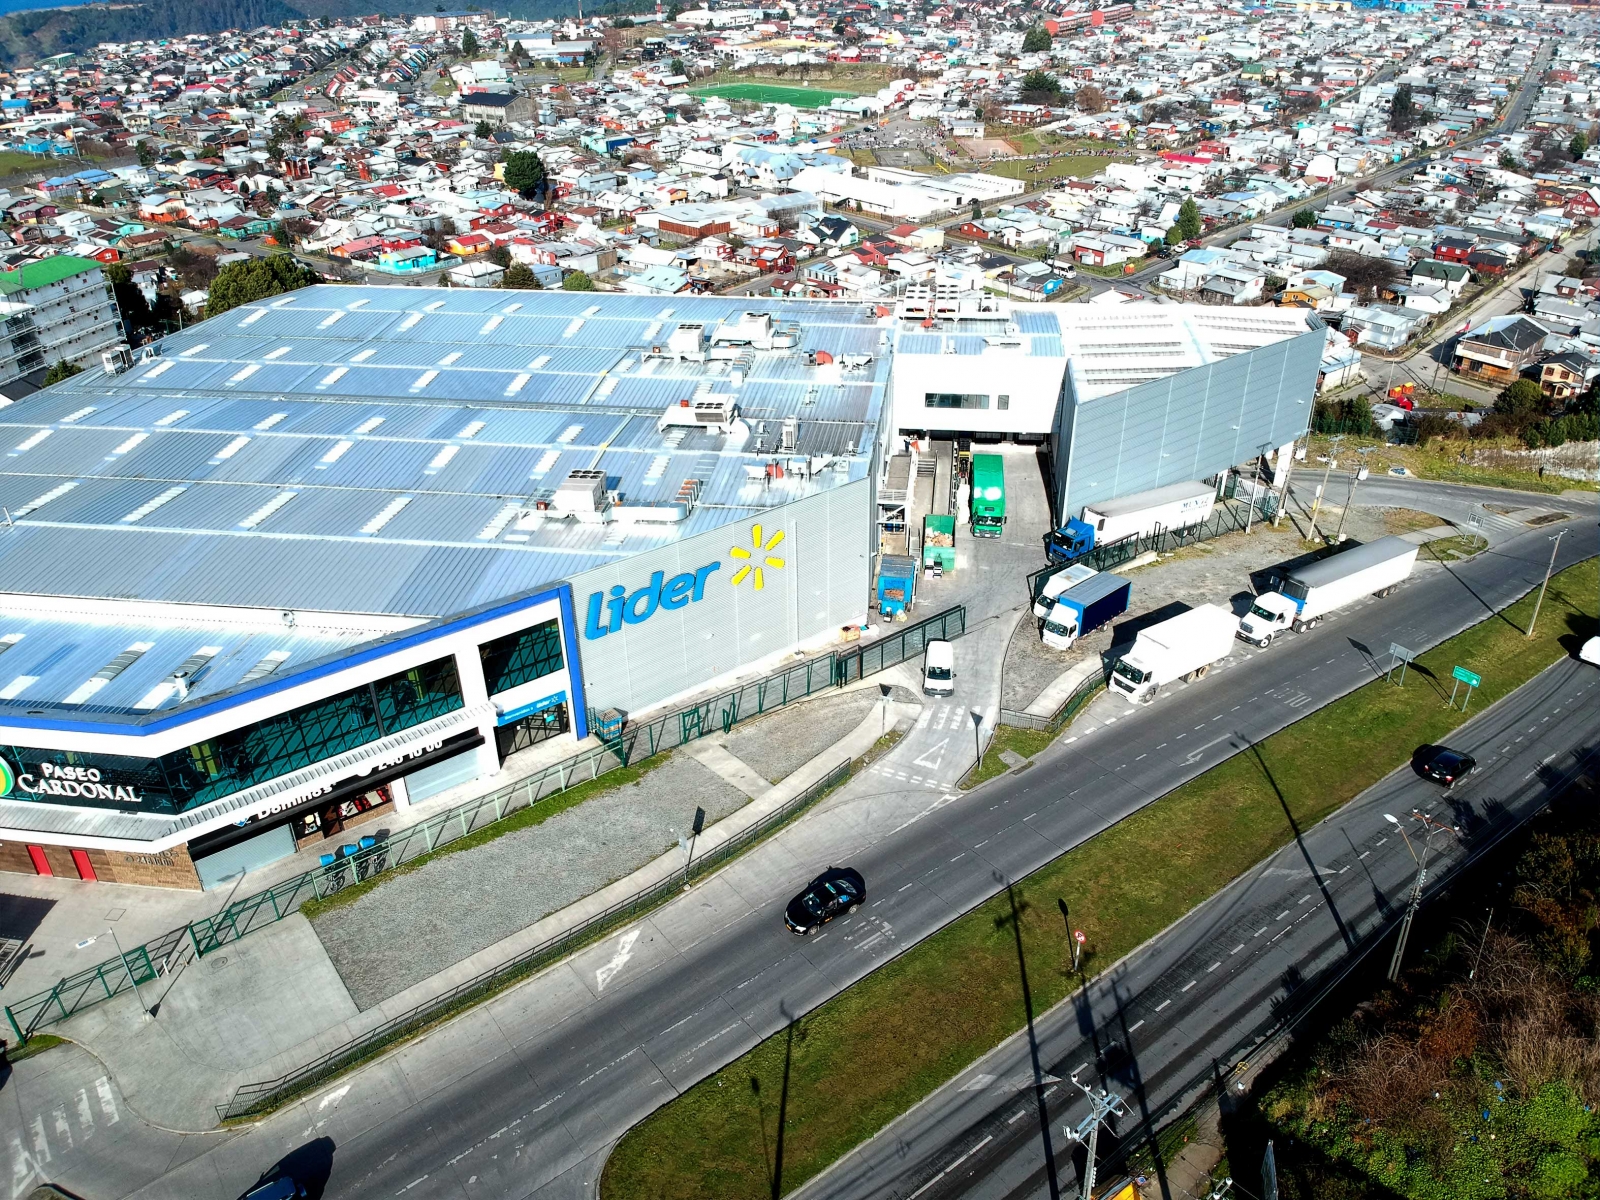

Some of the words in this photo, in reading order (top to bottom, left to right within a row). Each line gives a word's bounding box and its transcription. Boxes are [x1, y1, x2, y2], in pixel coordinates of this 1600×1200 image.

[585, 561, 721, 640] Lider
[18, 774, 142, 802] CARDONAL
[41, 762, 101, 782] PASEO
[257, 783, 332, 820] Dominos
